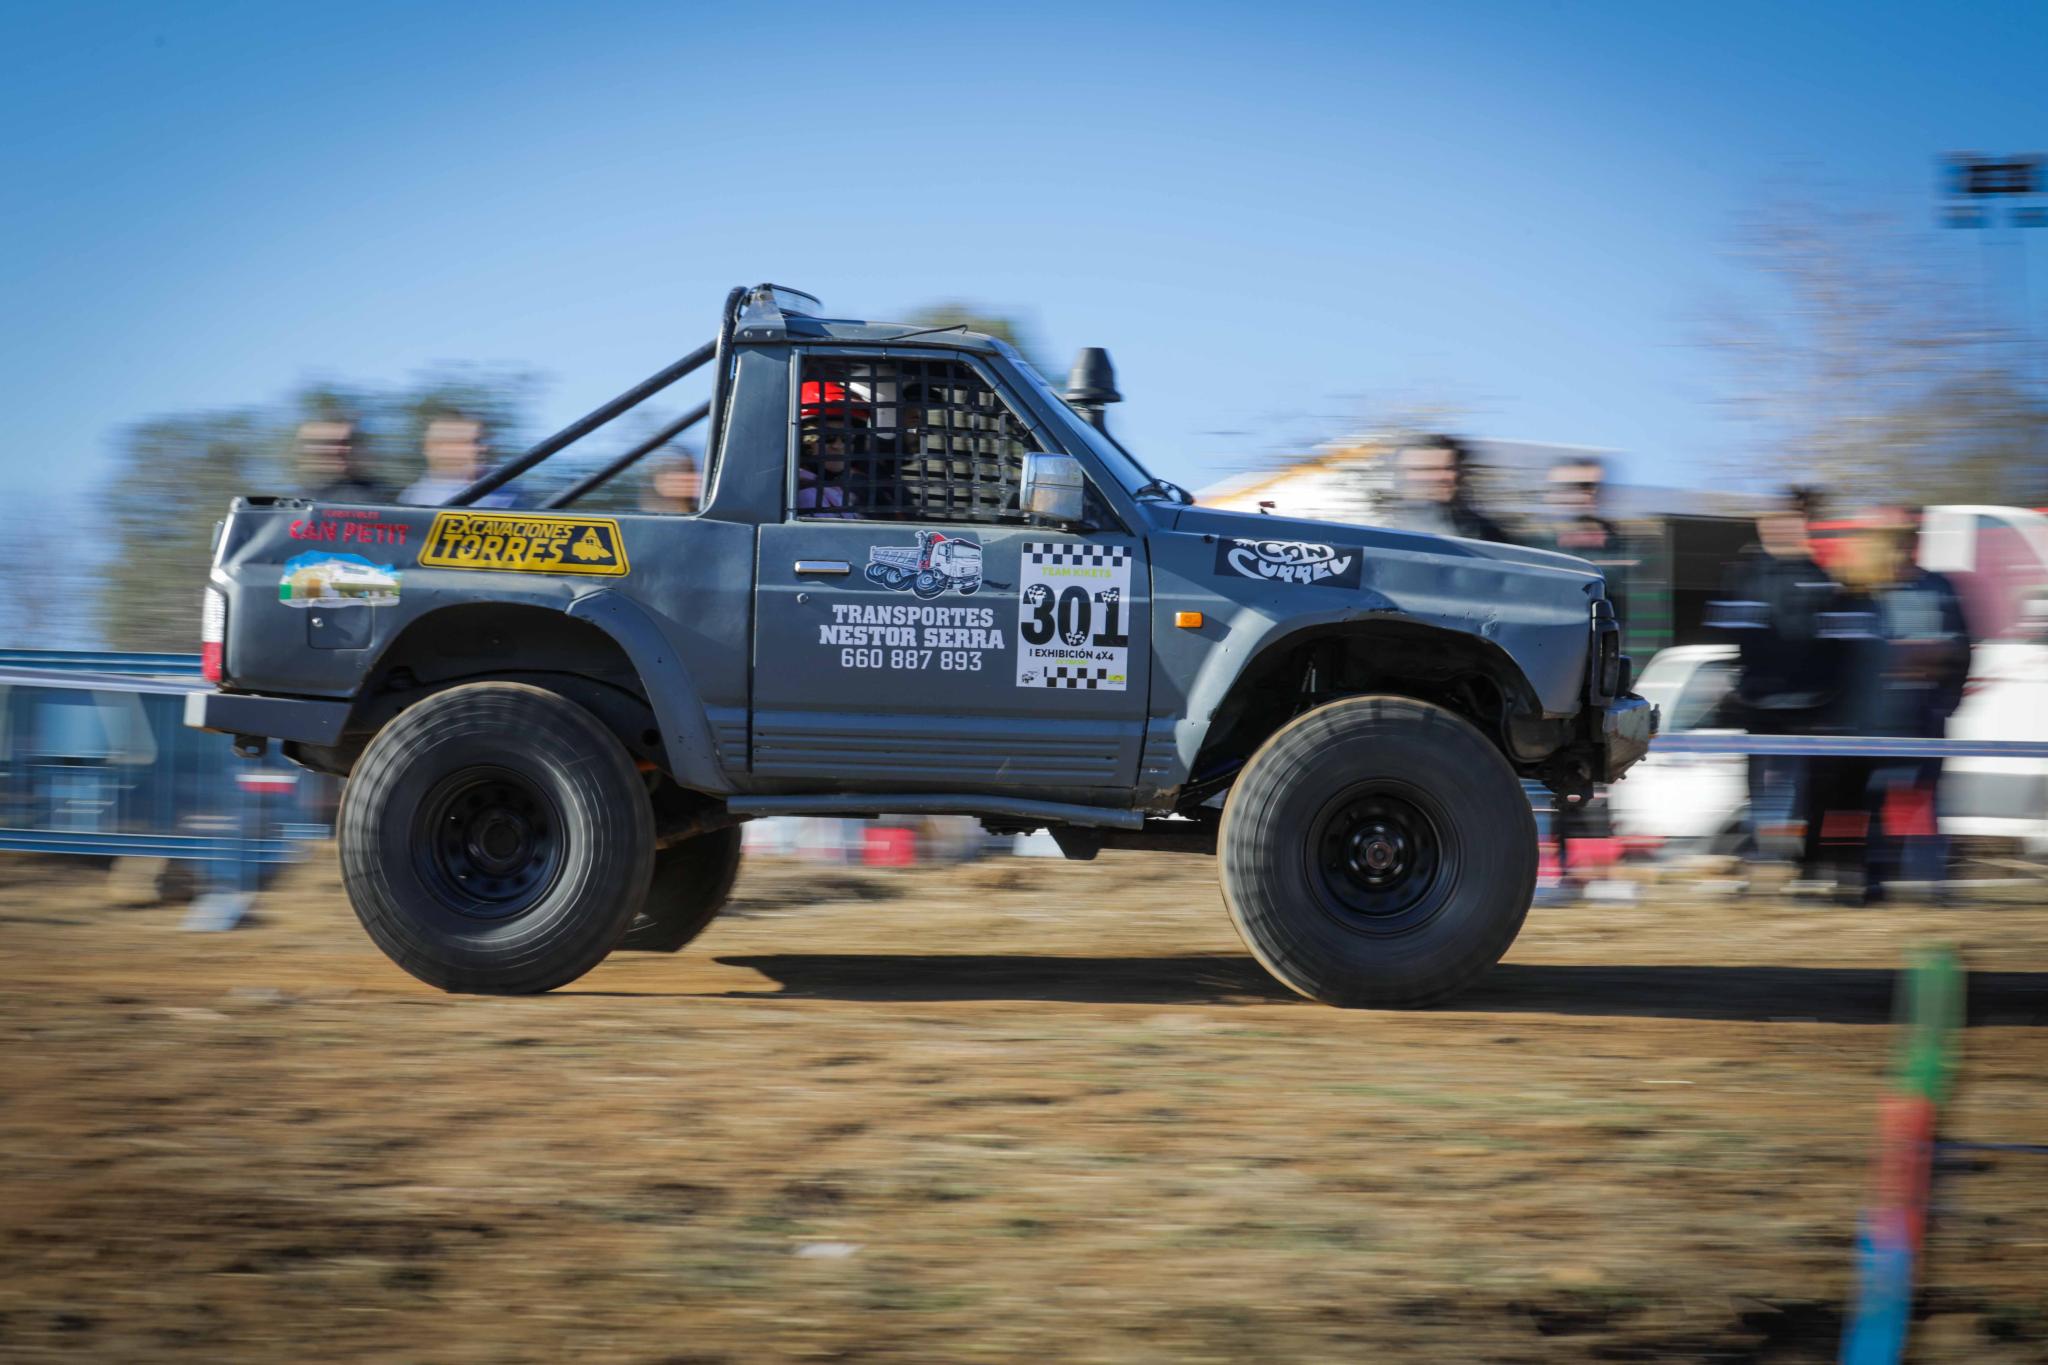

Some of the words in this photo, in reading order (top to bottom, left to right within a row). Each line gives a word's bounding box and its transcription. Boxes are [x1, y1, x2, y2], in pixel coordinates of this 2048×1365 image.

[289, 519, 337, 542] CAN
[343, 521, 410, 545] PETIT
[445, 517, 575, 539] EXCAVACIONES
[441, 534, 569, 564] TORRES
[1042, 566, 1071, 577] TEAM
[832, 604, 994, 628] TRANSPORTES
[1021, 583, 1129, 648] 301
[819, 625, 917, 647] NESTOR
[924, 628, 1005, 650] SERRA
[841, 648, 883, 669] 660
[890, 650, 933, 670] 887
[940, 651, 982, 671] 893
[1035, 648, 1093, 660] EXHIBICIÓN
